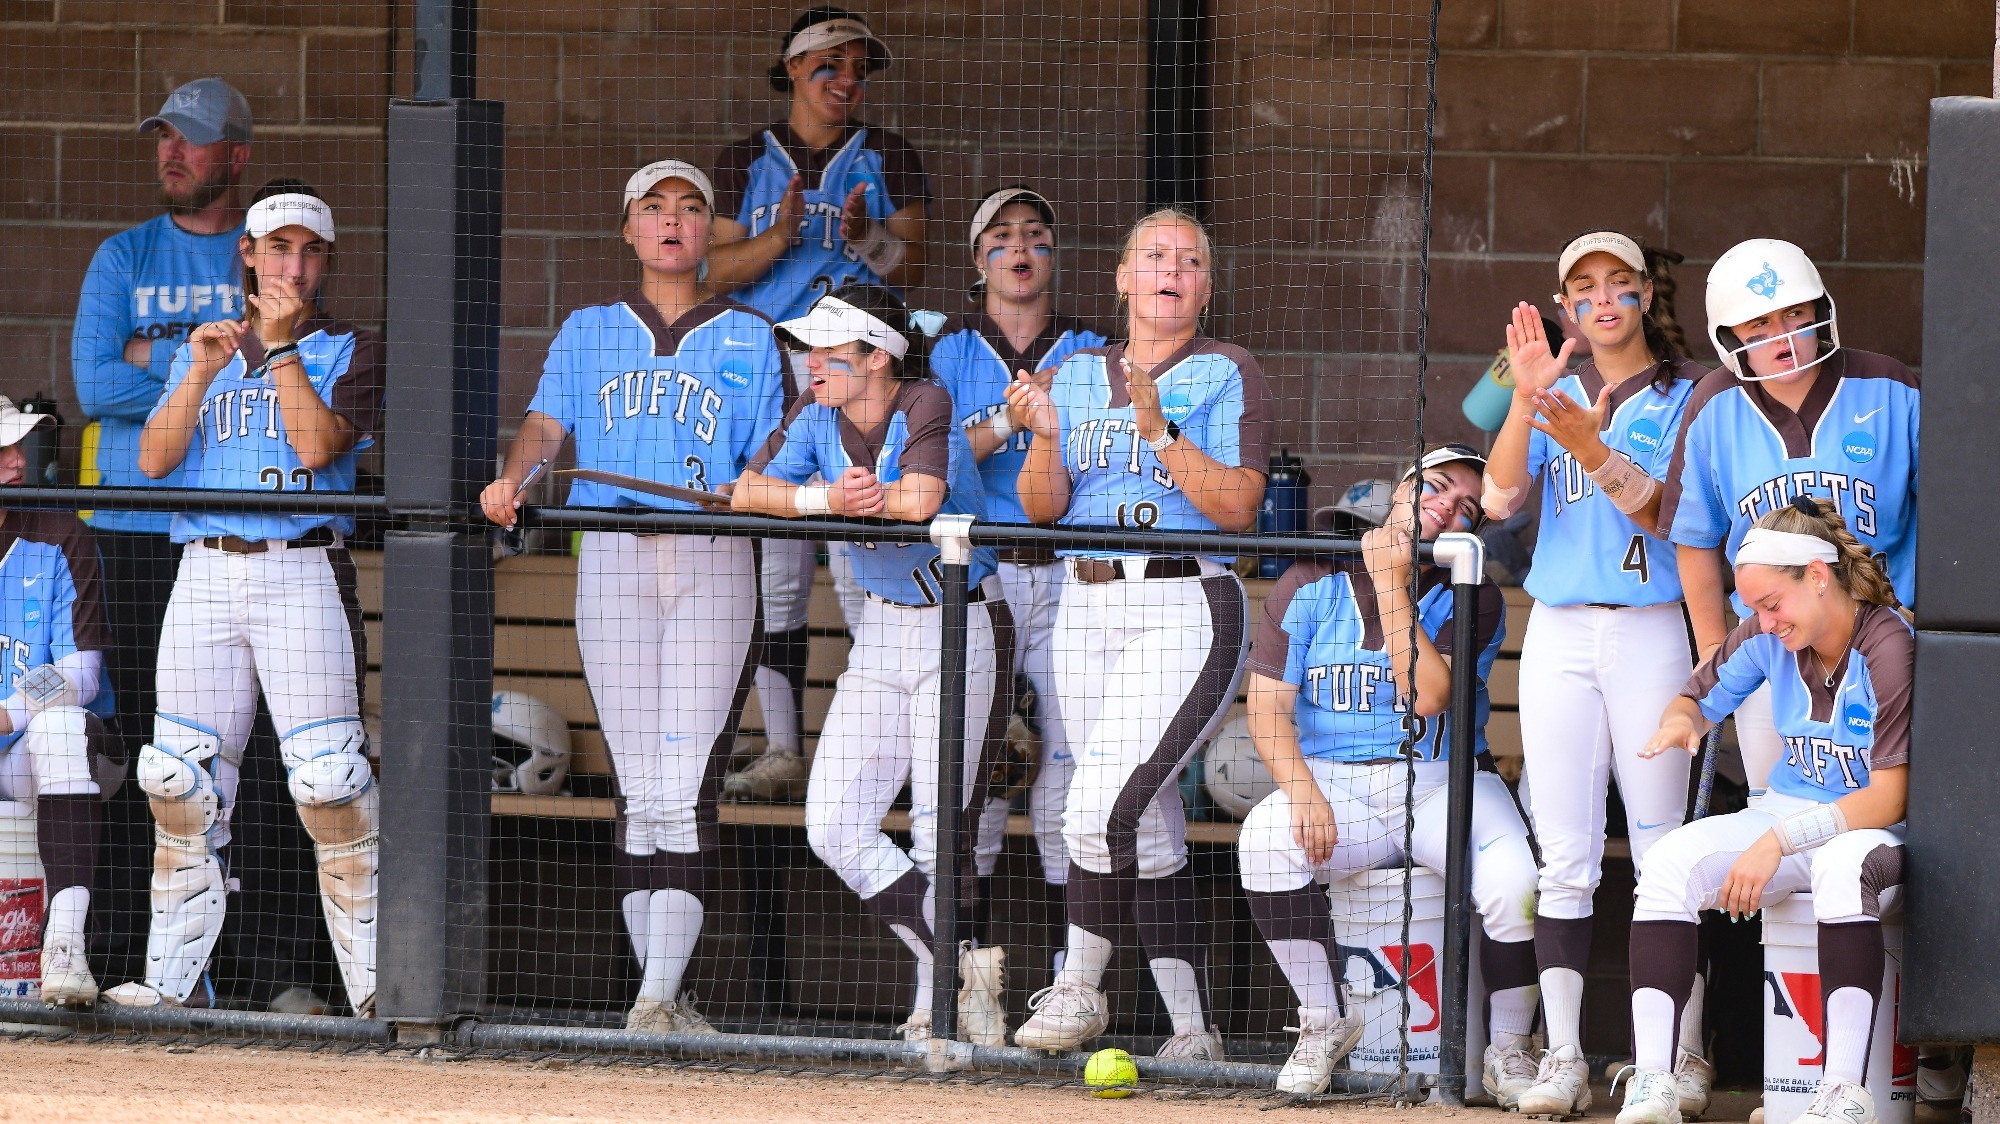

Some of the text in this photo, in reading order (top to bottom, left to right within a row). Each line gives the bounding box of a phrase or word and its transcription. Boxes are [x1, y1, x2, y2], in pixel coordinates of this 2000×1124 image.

[135, 283, 245, 318] TUFT
[722, 369, 748, 386] NCAA
[598, 369, 723, 446] TUFTS
[1161, 406, 1188, 414] NCAA
[1629, 430, 1658, 448] NCAA
[1845, 444, 1874, 457] NCAA
[684, 454, 710, 493] 3
[1621, 533, 1650, 585] 4
[1848, 716, 1872, 729] NCAA
[1396, 710, 1447, 761] 21
[1361, 1054, 1390, 1062] LEAGUE
